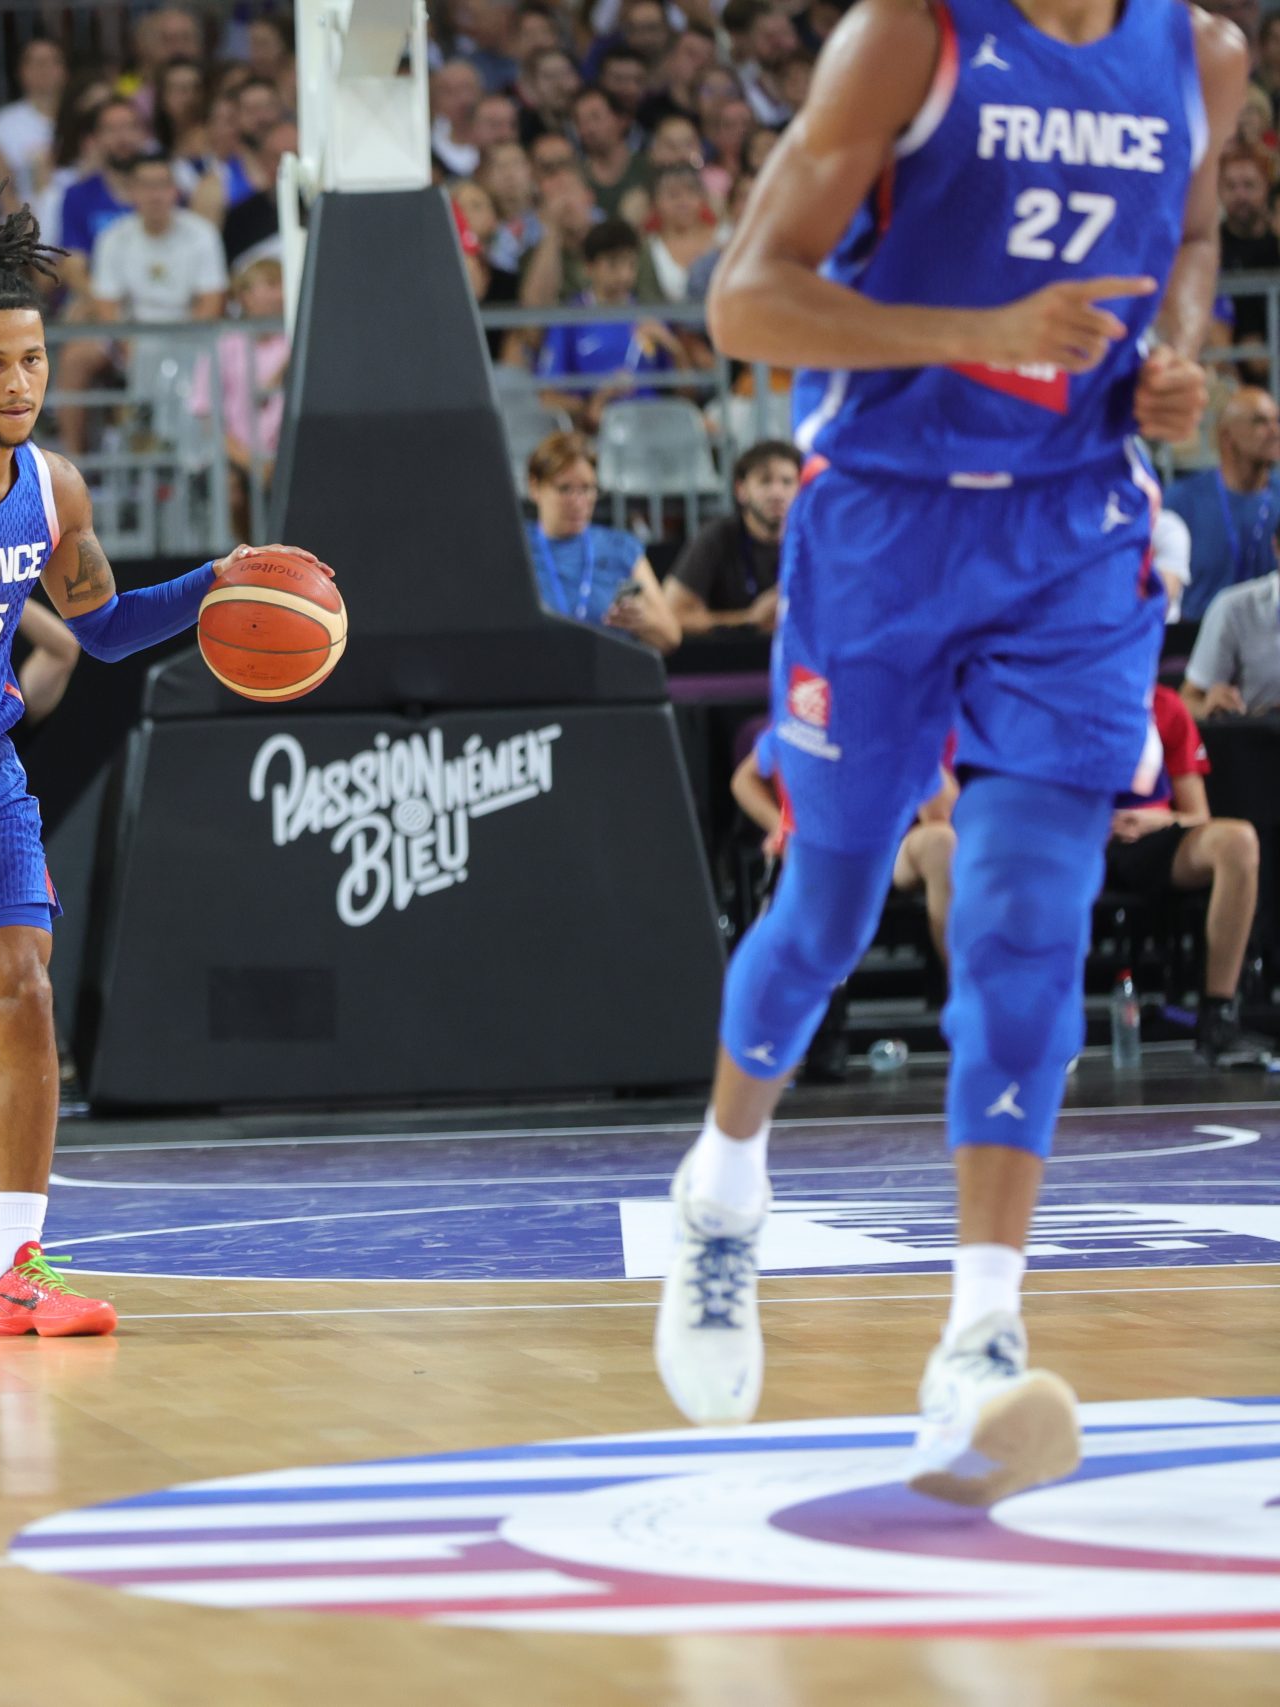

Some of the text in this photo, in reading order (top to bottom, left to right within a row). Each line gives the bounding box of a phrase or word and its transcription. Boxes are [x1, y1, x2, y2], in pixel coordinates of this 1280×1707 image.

[976, 103, 1169, 174] FRANCE
[1006, 187, 1117, 264] 27
[240, 562, 304, 581] molten
